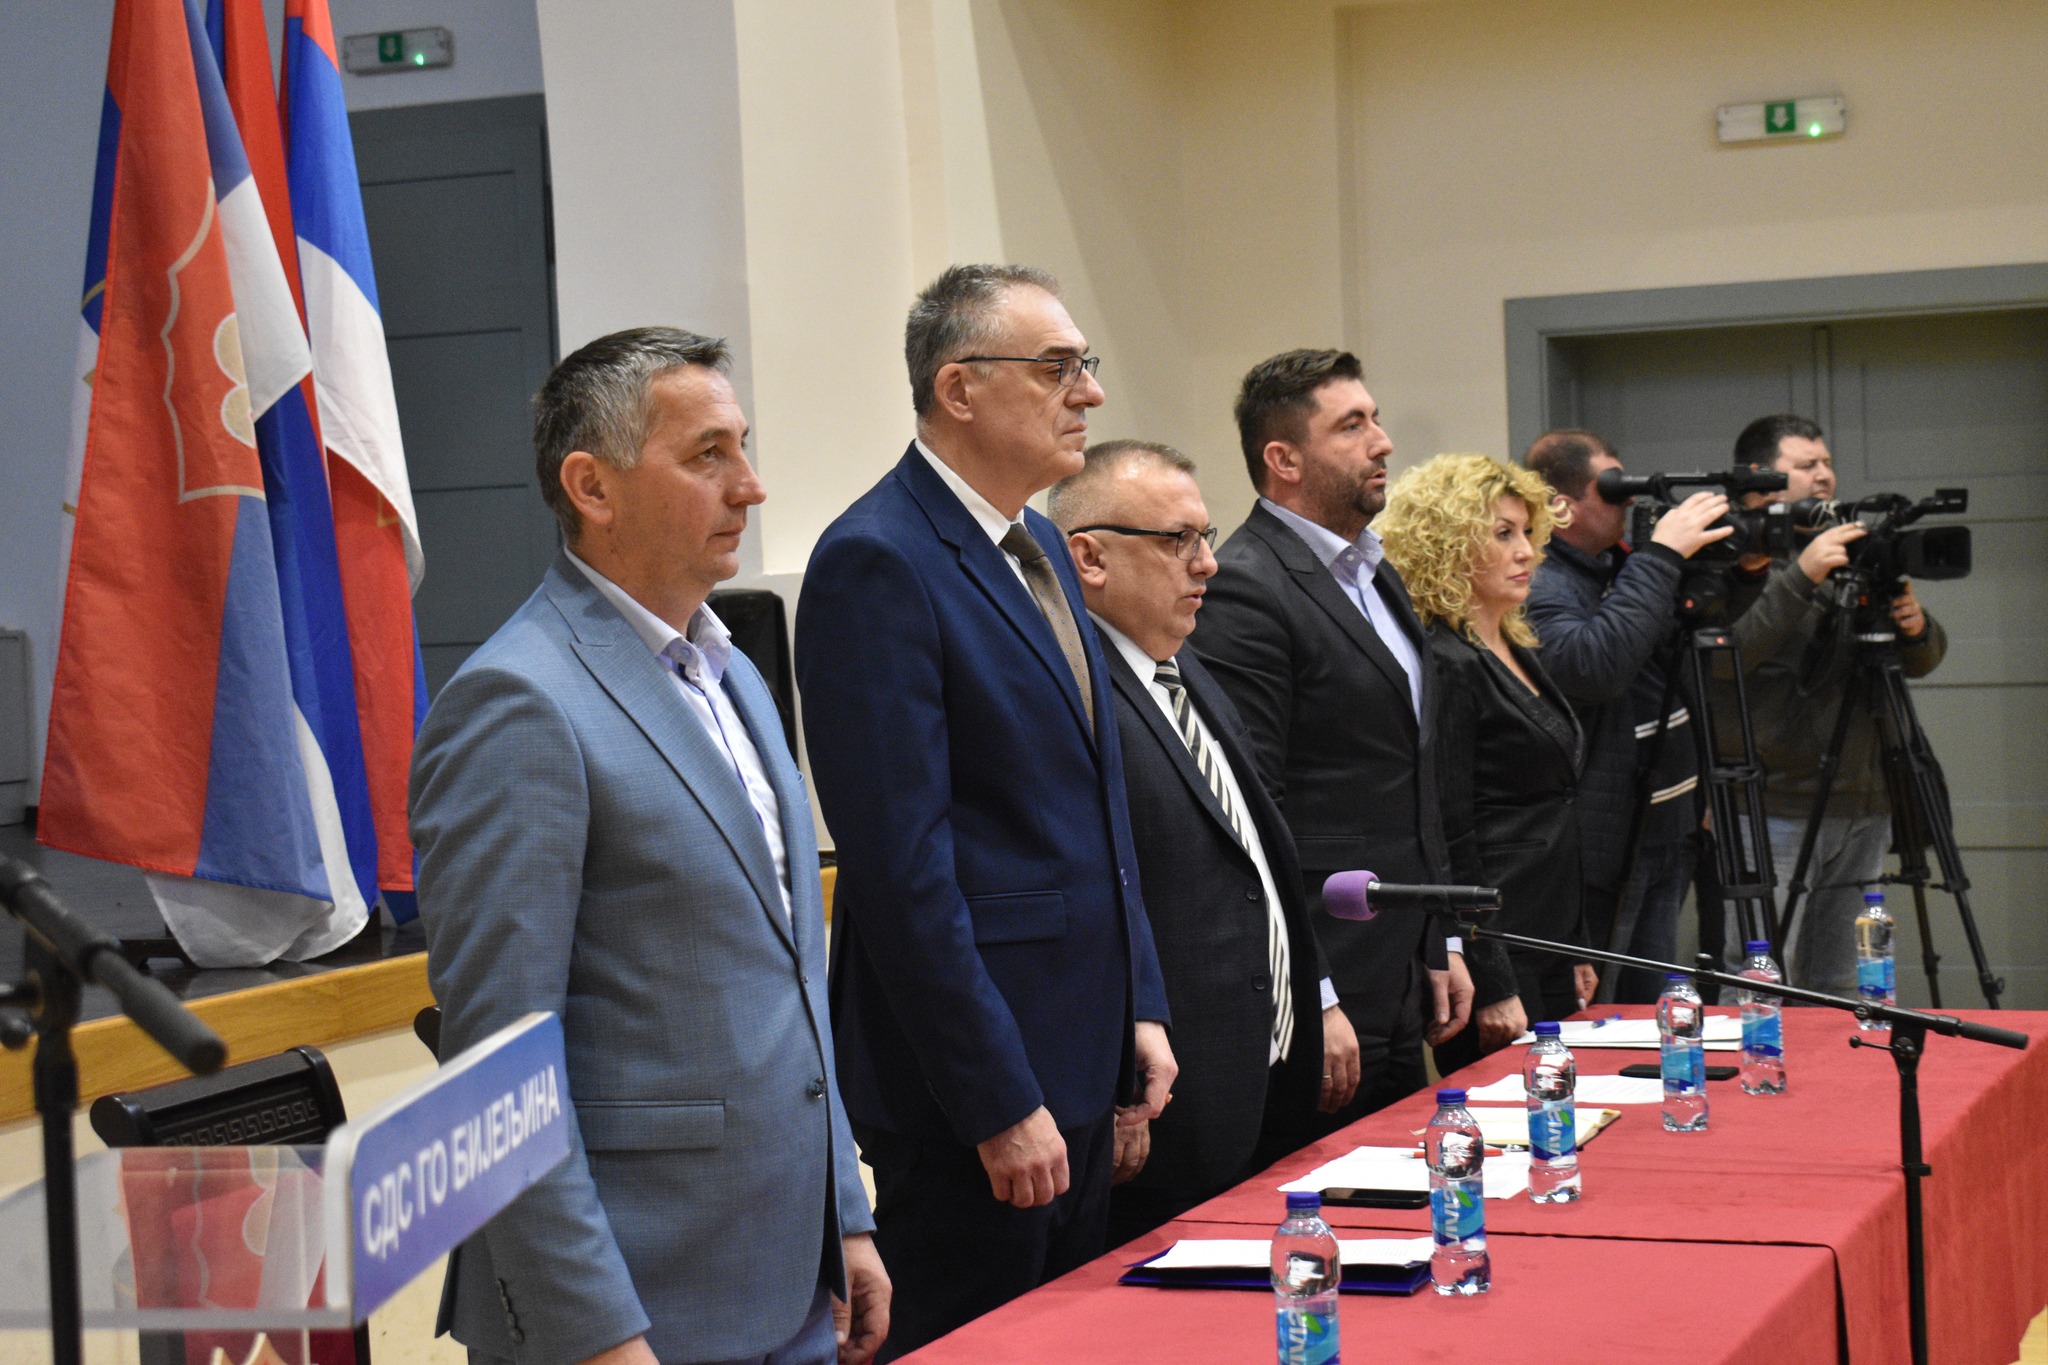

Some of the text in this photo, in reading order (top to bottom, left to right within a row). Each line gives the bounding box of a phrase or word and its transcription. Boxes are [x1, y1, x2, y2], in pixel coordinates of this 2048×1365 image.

[362, 1064, 561, 1262] СДС ГО БИЈЕЉИНА
